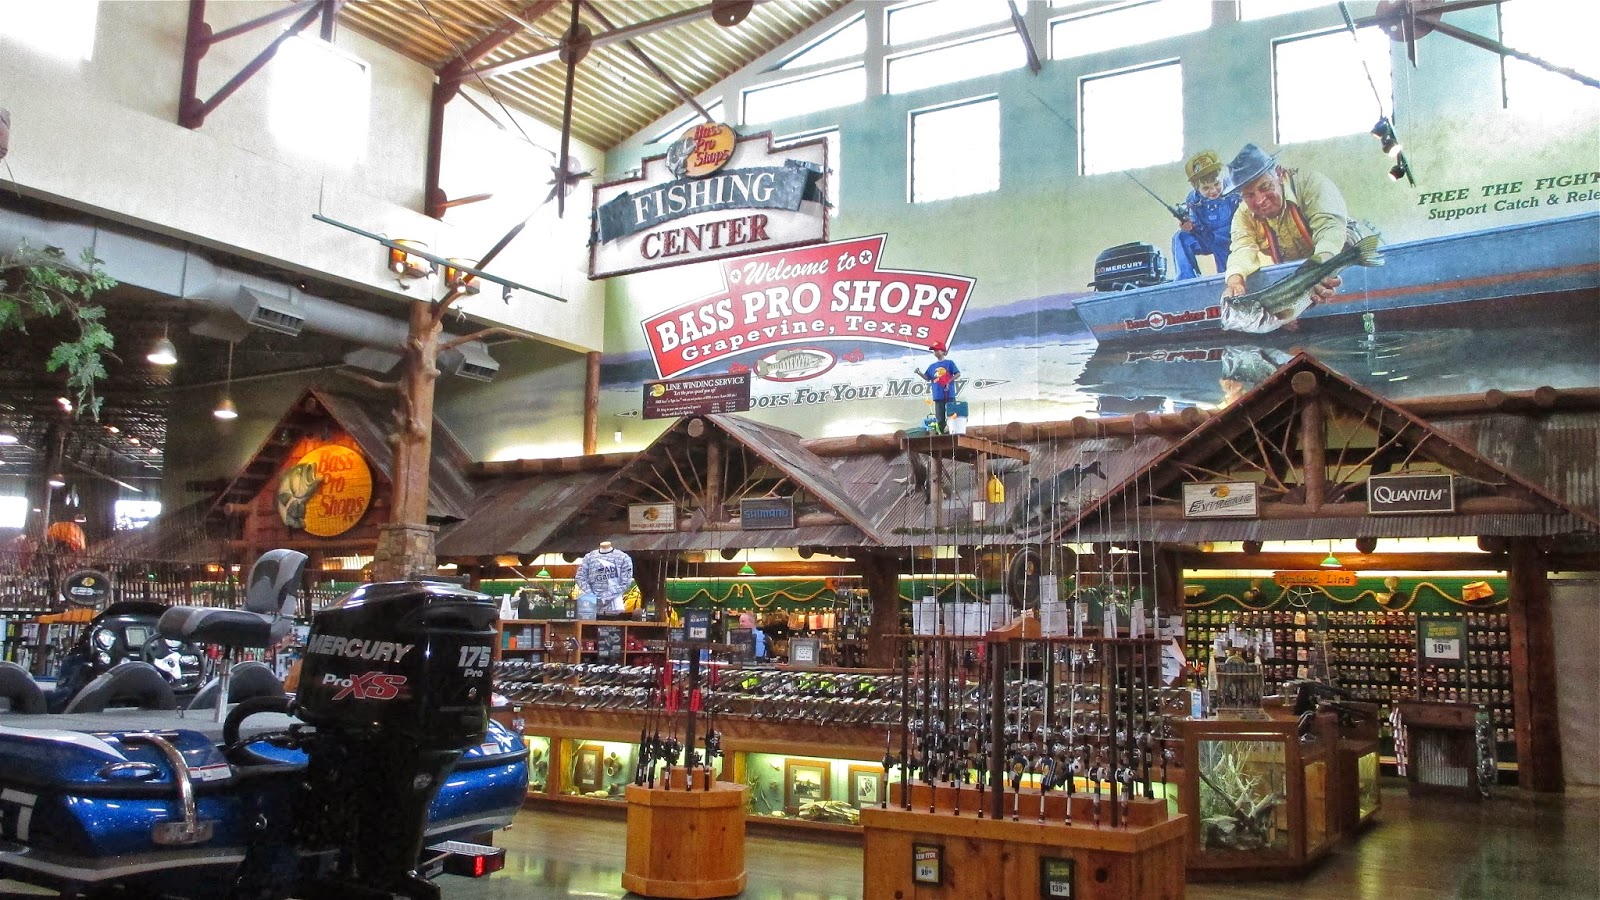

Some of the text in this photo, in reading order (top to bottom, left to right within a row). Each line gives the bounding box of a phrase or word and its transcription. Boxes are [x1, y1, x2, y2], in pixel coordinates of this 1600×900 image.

[694, 139, 716, 153] Pro
[694, 149, 731, 167] Shops
[631, 173, 775, 226] FISHING
[1418, 187, 1470, 206] FREE
[1481, 181, 1523, 198] THE
[1428, 203, 1487, 221] Support
[1493, 196, 1539, 212] Catch
[1546, 194, 1559, 205] &
[640, 213, 771, 260] CENTER
[743, 251, 857, 285] Welcome to
[1105, 261, 1143, 272] MERCURY
[655, 279, 959, 354] BASS PRO SHOPS
[681, 315, 930, 362] Grapevine, Texas
[666, 383, 681, 391] LINE
[682, 379, 714, 390] WINDING
[715, 377, 744, 386] SERVICE
[750, 391, 789, 409] oors
[794, 387, 829, 406] For
[832, 383, 881, 402] Your
[318, 450, 355, 473] Bass
[317, 472, 345, 495] Pro
[1374, 485, 1442, 505] QUANTUM
[318, 494, 365, 522] Shops
[744, 508, 788, 519] SHIMANO
[1187, 493, 1254, 514] EXTREME
[1326, 574, 1351, 584] Line
[307, 634, 416, 664] MERCURY
[458, 645, 492, 668] 175
[464, 668, 483, 678] Pro
